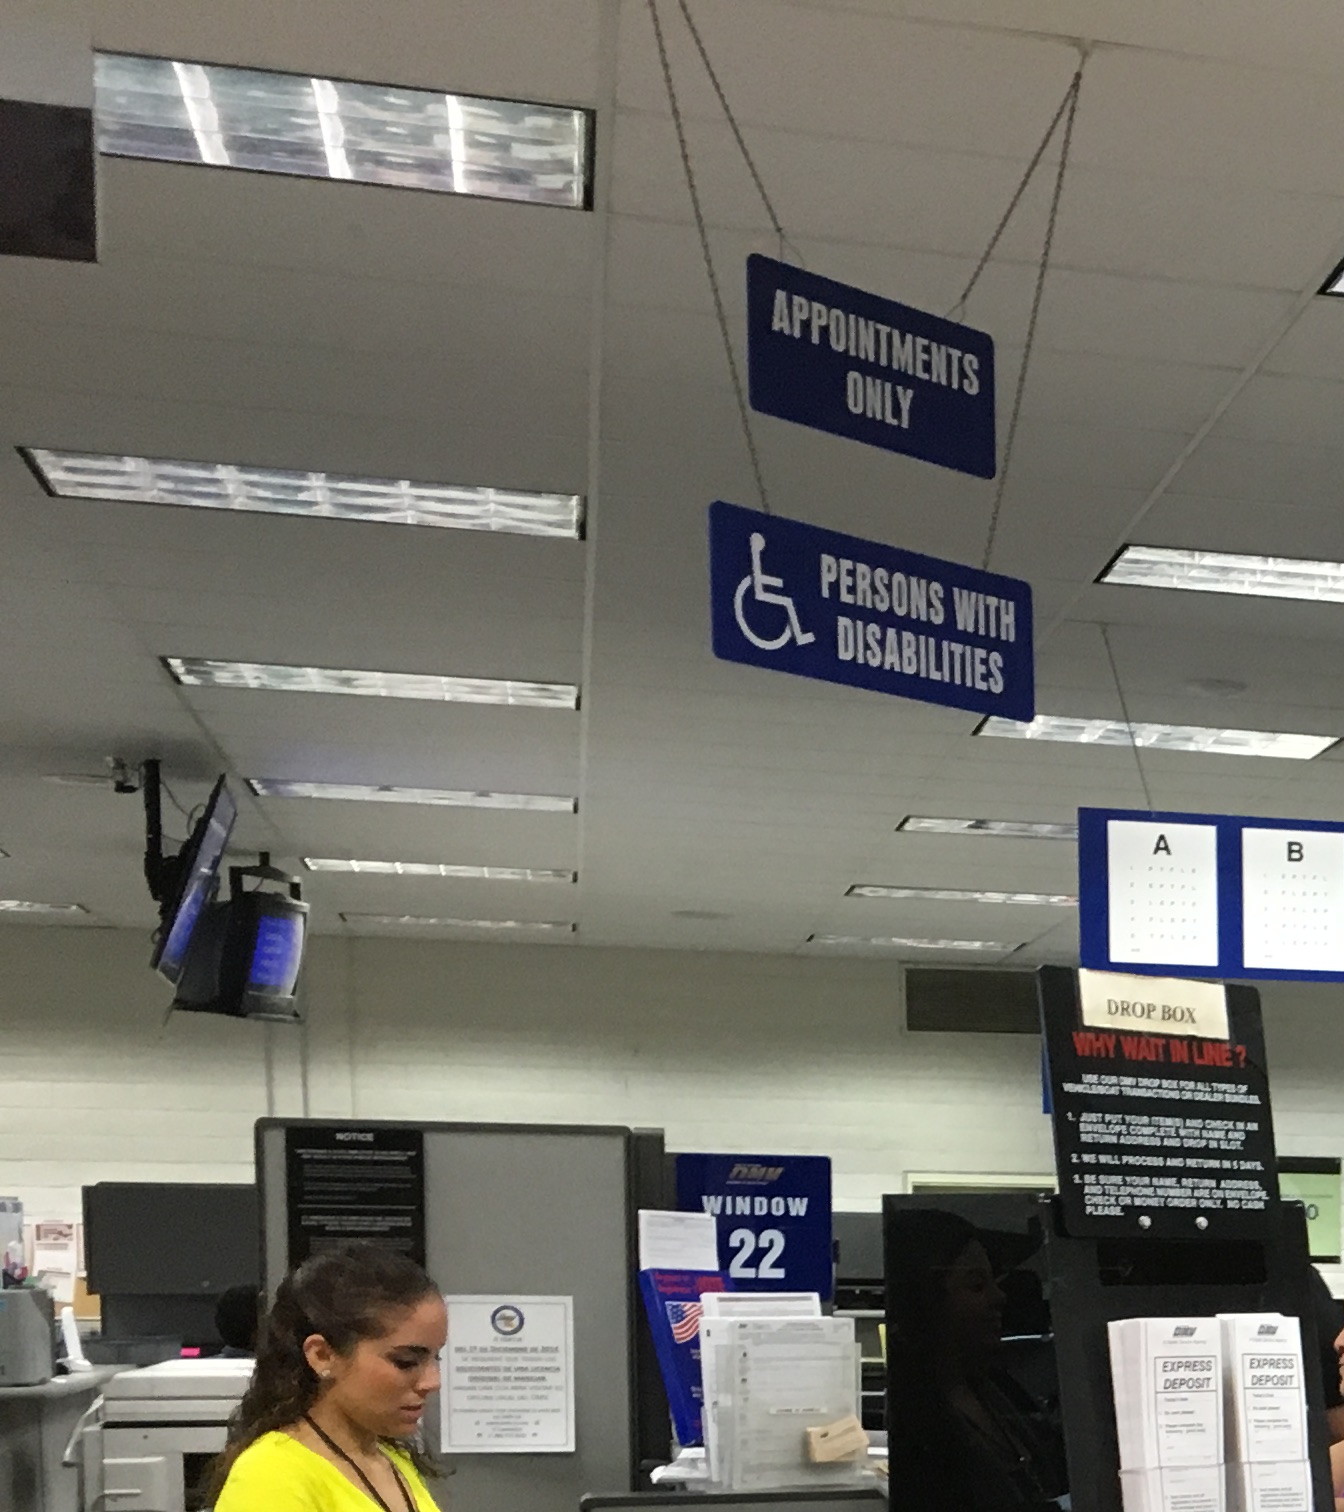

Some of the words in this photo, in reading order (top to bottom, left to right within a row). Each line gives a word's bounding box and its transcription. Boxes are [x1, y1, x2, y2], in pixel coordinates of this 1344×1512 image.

[771, 289, 980, 396] APPOINTMENTS
[845, 370, 914, 429] ONLY
[820, 554, 945, 624] PERSONS
[953, 586, 1016, 643] WITH
[837, 616, 1004, 694] DISABILITIES
[1153, 833, 1172, 856] A
[1287, 841, 1304, 862] B
[1106, 998, 1157, 1020] DROP
[1161, 1004, 1198, 1024] BOX
[1072, 1031, 1117, 1059] WHY
[1120, 1035, 1166, 1063] WAIT
[1169, 1039, 1190, 1064] IN
[1193, 1041, 1234, 1068] LINE
[701, 1195, 809, 1217] WINDOW
[728, 1228, 786, 1279] 22
[1162, 1360, 1213, 1373] EXPRESS
[1250, 1358, 1295, 1370] EXPRESS
[1163, 1377, 1212, 1390] DEPOSIT
[1251, 1374, 1295, 1386] DEPOSIT
